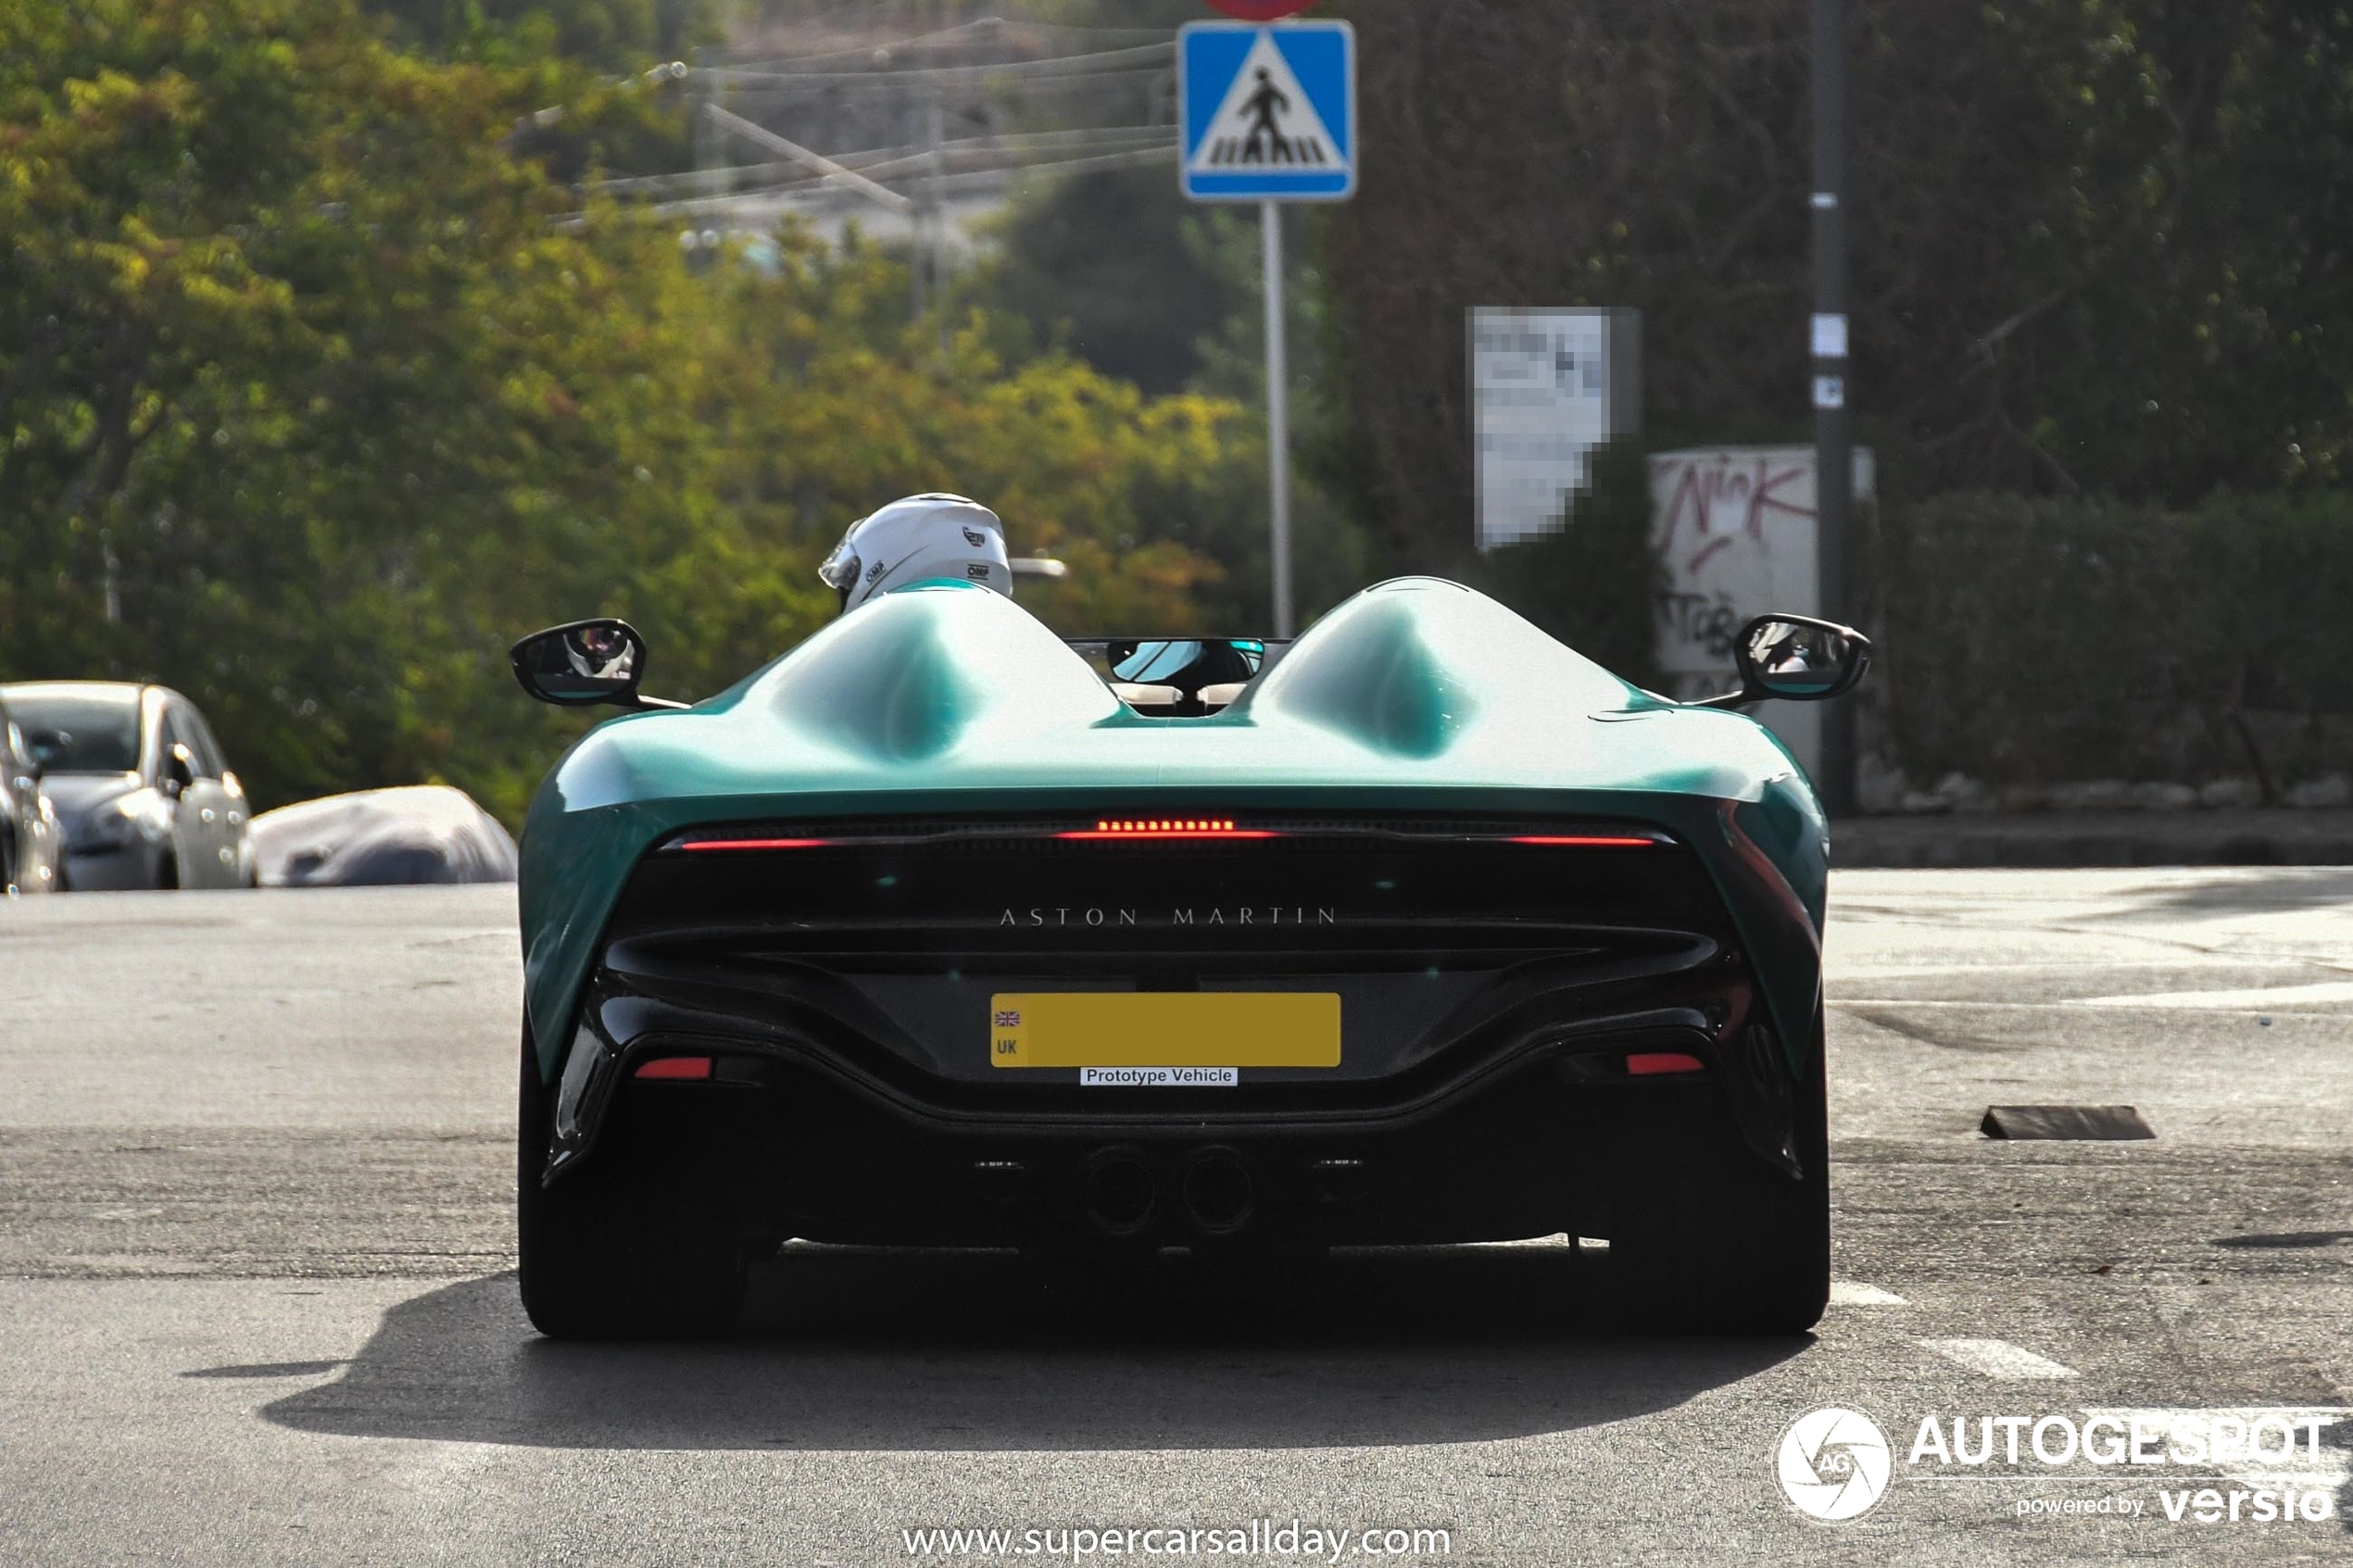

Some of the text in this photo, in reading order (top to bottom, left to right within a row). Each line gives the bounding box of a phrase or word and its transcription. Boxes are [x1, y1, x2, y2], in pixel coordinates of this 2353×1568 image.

[865, 562, 885, 583] OMP
[967, 567, 989, 576] OMP
[1000, 907, 1336, 926] ASTON MARTIN
[997, 1039, 1017, 1055] UK
[1087, 1068, 1233, 1085] Prototype Vehicle
